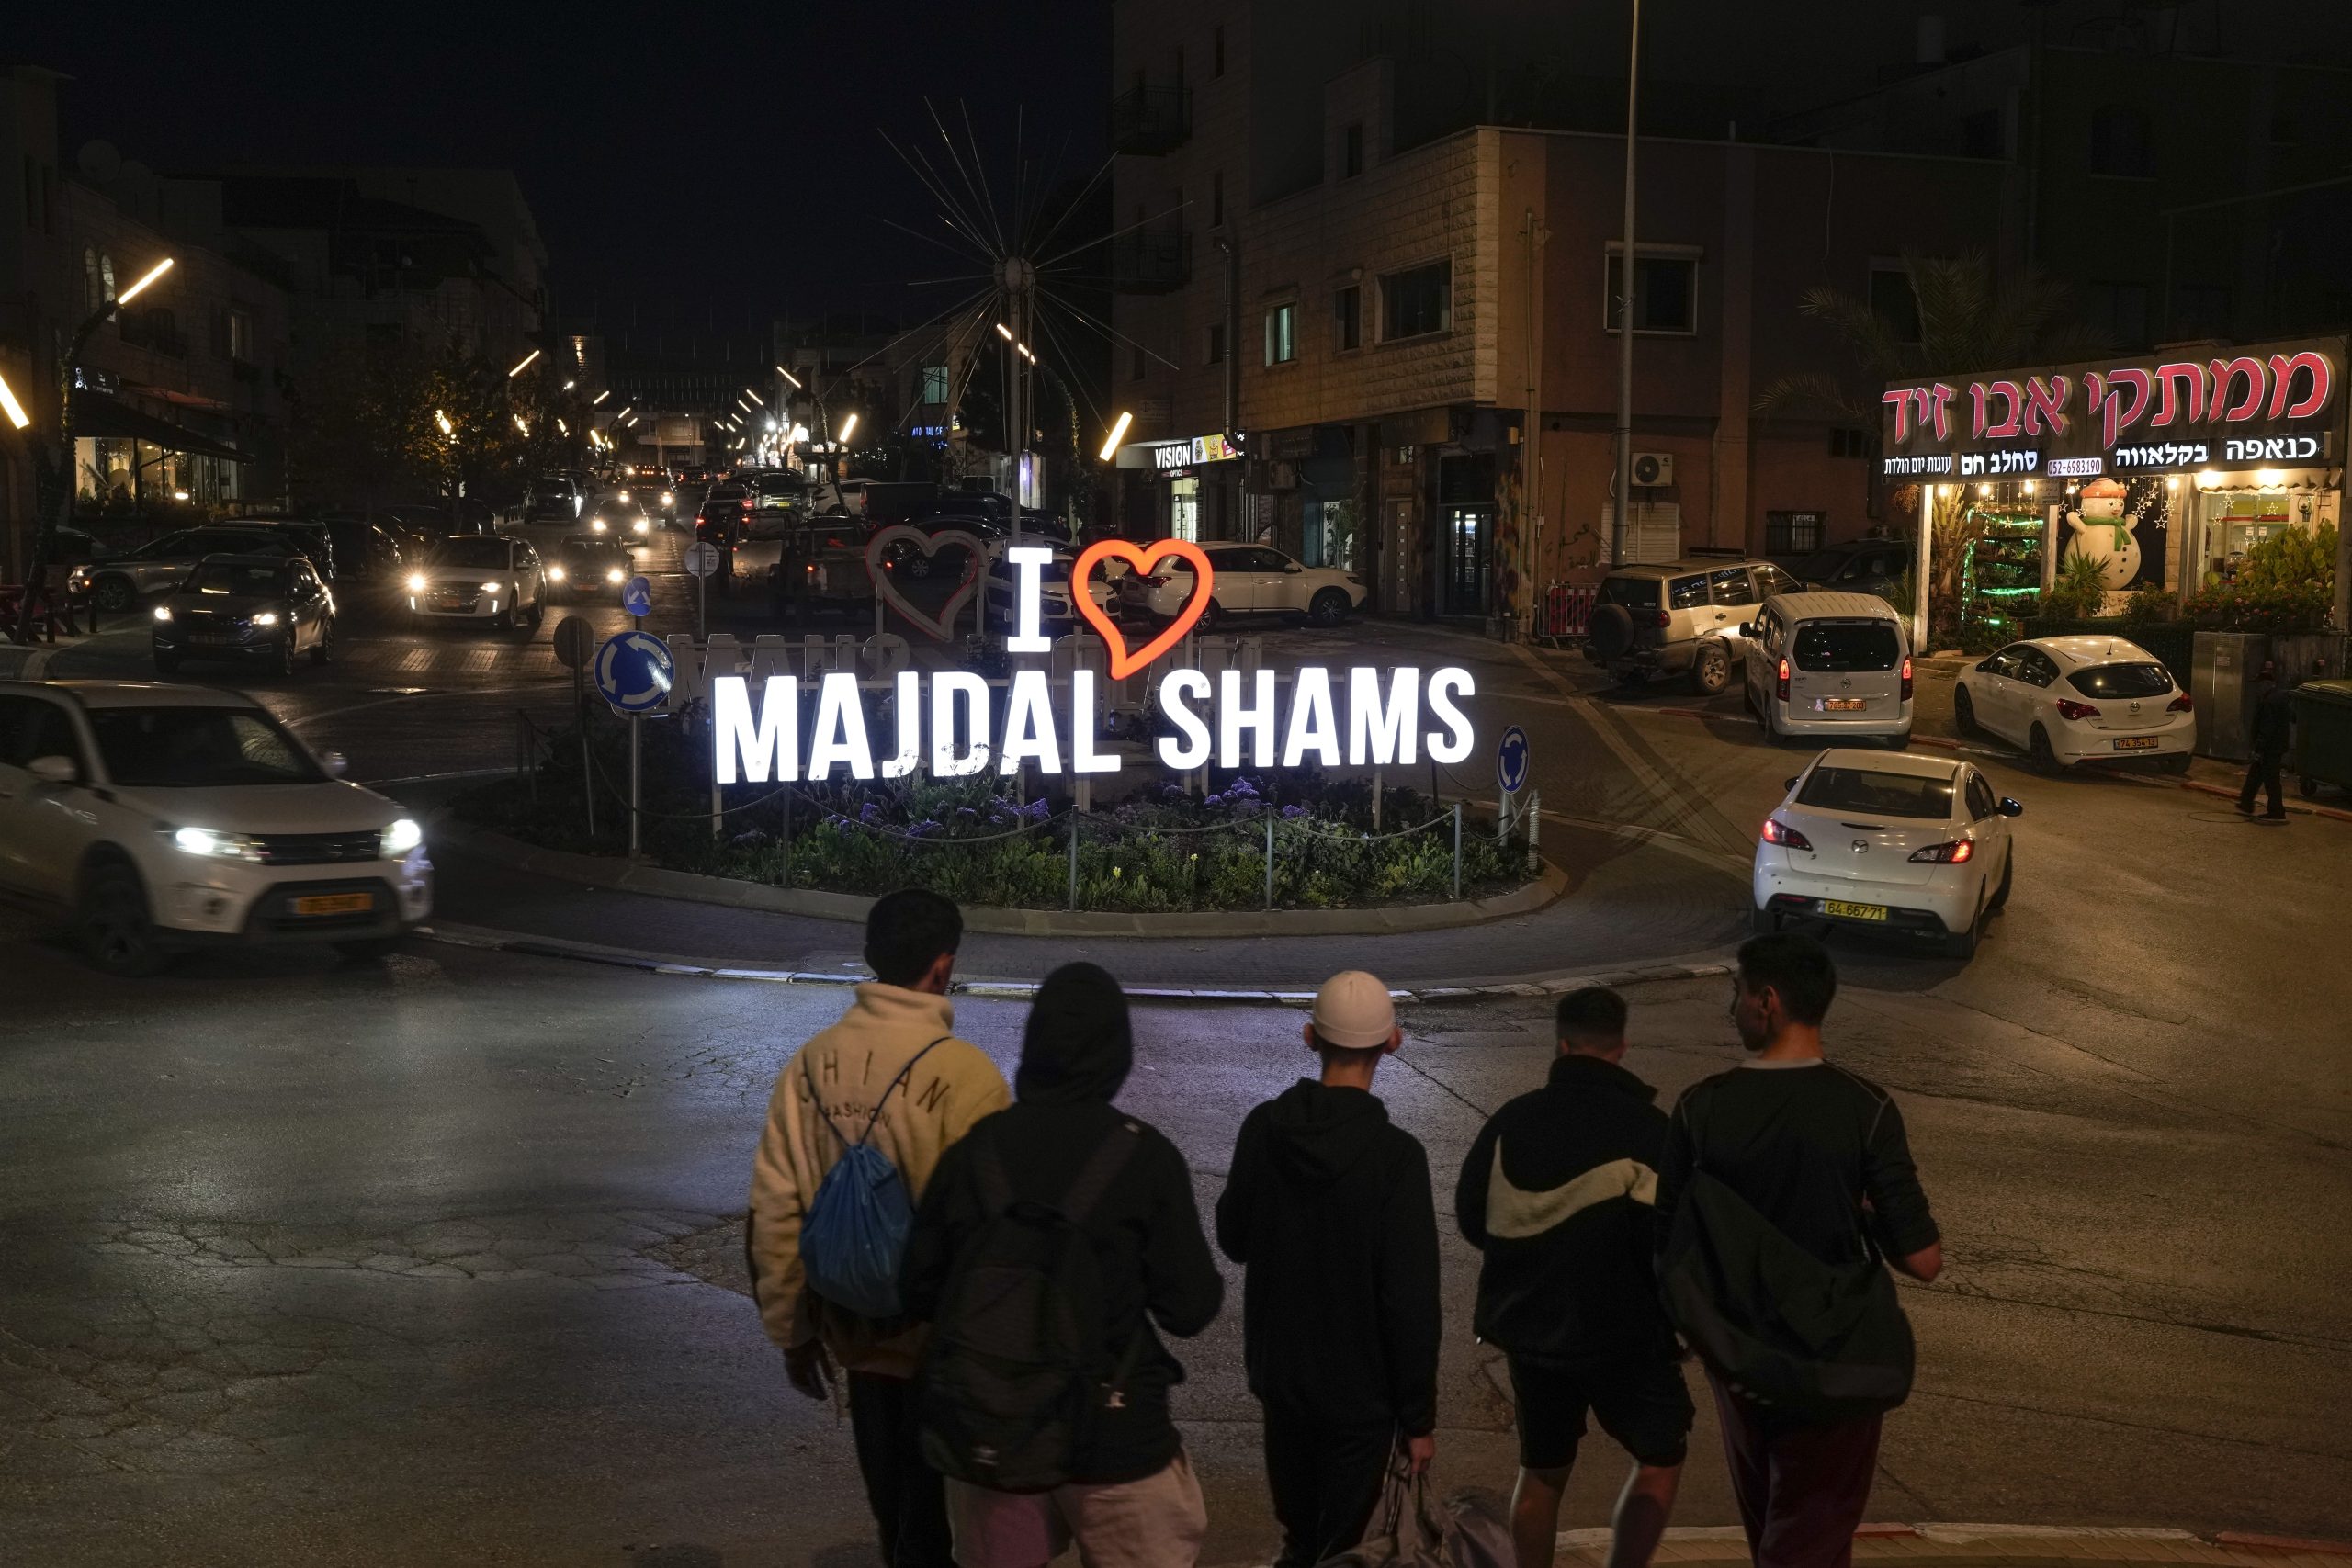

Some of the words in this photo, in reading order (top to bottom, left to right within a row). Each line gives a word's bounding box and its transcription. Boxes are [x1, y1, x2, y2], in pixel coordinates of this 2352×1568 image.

[1969, 375, 2065, 440] אבו
[2082, 352, 2330, 450] ממתקי
[1882, 382, 1952, 444] זיד
[1155, 445, 1191, 468] VISION
[2116, 442, 2209, 467] בקלאווה
[2226, 437, 2317, 460] כנאפה
[1170, 468, 1183, 478] OPTICS
[1883, 456, 1910, 475] הולדת
[1911, 457, 1926, 473] יום
[1927, 456, 1951, 475] עוגות
[1961, 454, 1985, 476] חם
[1990, 449, 2038, 474] סחלב
[2048, 459, 2100, 475] 052-6983190
[1007, 547, 1054, 653] I
[713, 670, 1121, 784] MAJDAL
[1158, 667, 1475, 771] SHAMS
